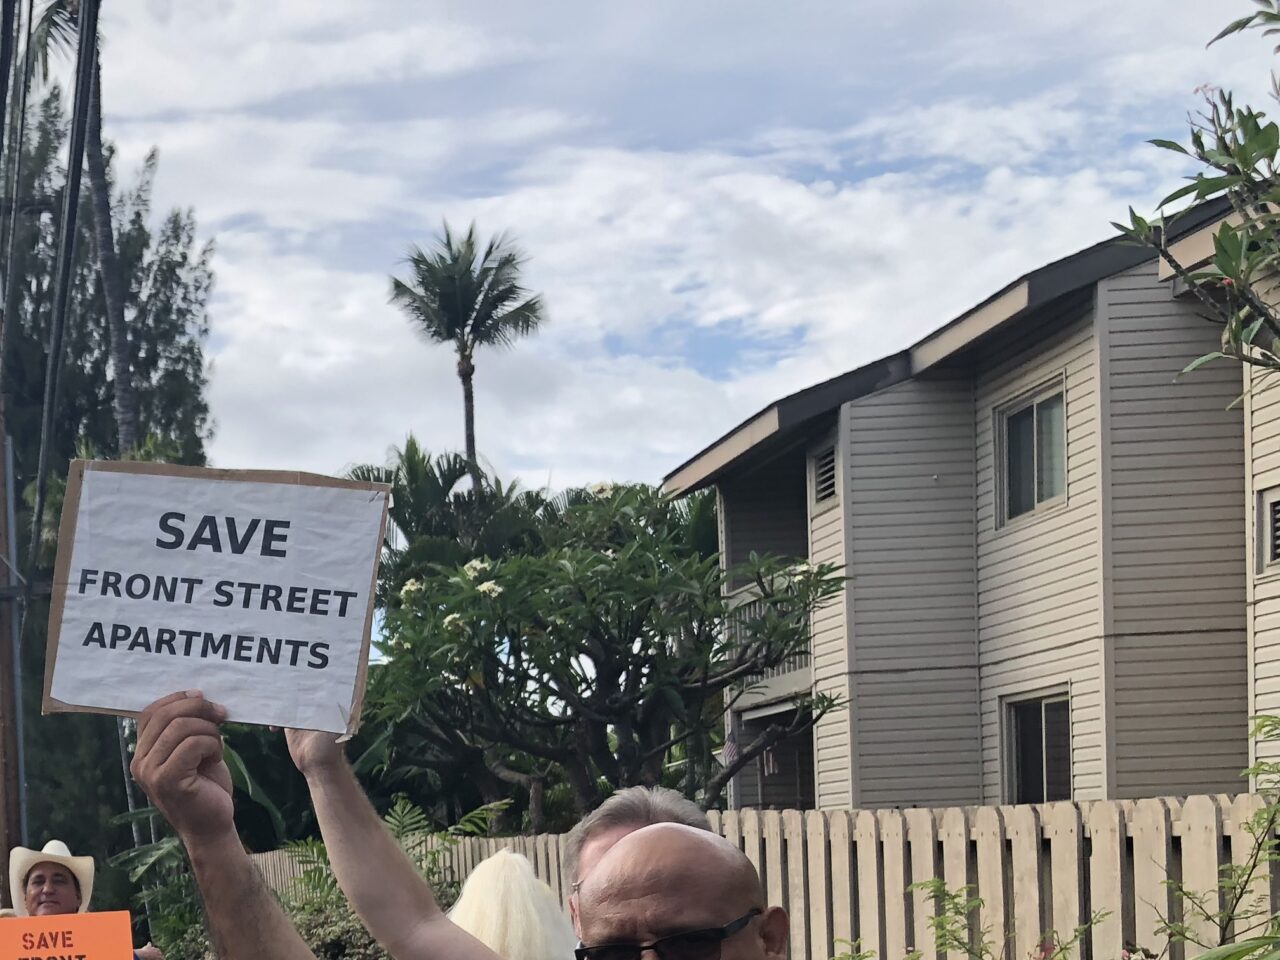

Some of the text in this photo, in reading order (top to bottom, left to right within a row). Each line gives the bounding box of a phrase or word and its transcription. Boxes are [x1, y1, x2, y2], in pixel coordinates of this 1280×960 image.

[156, 512, 291, 558] SAVE
[79, 569, 358, 617] FRONT STREET
[82, 622, 330, 669] APARTMENTS
[22, 931, 74, 950] SAVE
